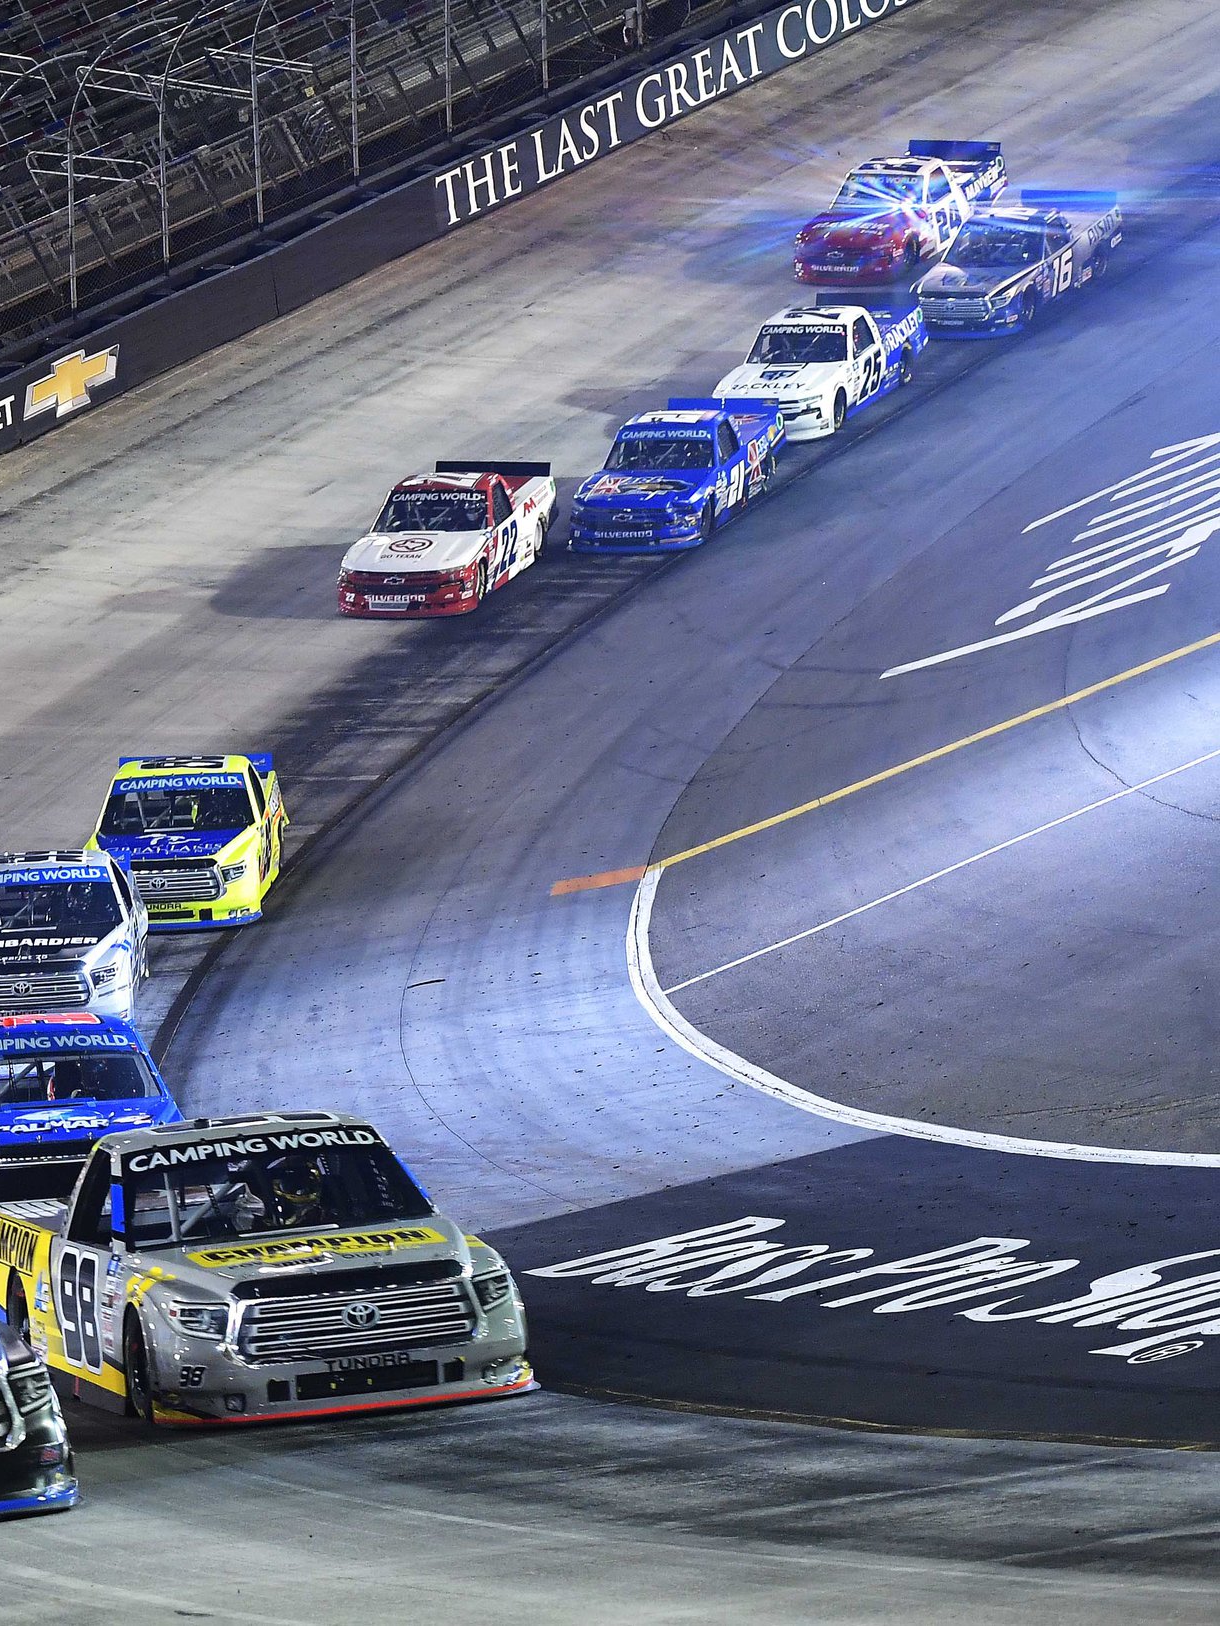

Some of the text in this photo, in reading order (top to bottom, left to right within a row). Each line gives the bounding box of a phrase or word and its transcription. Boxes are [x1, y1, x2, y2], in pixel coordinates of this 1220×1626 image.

[436, 0, 908, 225] THE LAST GREAT COL
[1052, 249, 1073, 297] 16
[762, 325, 843, 335] CAMPING WORLD
[858, 351, 881, 403] 25
[622, 430, 707, 440] CAMPING WORLD
[392, 492, 480, 502] CAMPING WORLD
[499, 519, 518, 572] 22
[120, 776, 238, 791] CAMPING WORLD
[45, 868, 101, 880] WORLD
[144, 903, 182, 911] UNDRA
[53, 1034, 128, 1047] WORLD
[130, 1129, 375, 1172] CAMPING WORLD
[207, 1230, 424, 1262] CHAMPION
[744, 1236, 1080, 1313] Pro
[60, 1245, 103, 1376] 98
[324, 1352, 411, 1372] TUNDRA
[180, 1365, 206, 1389] 98
